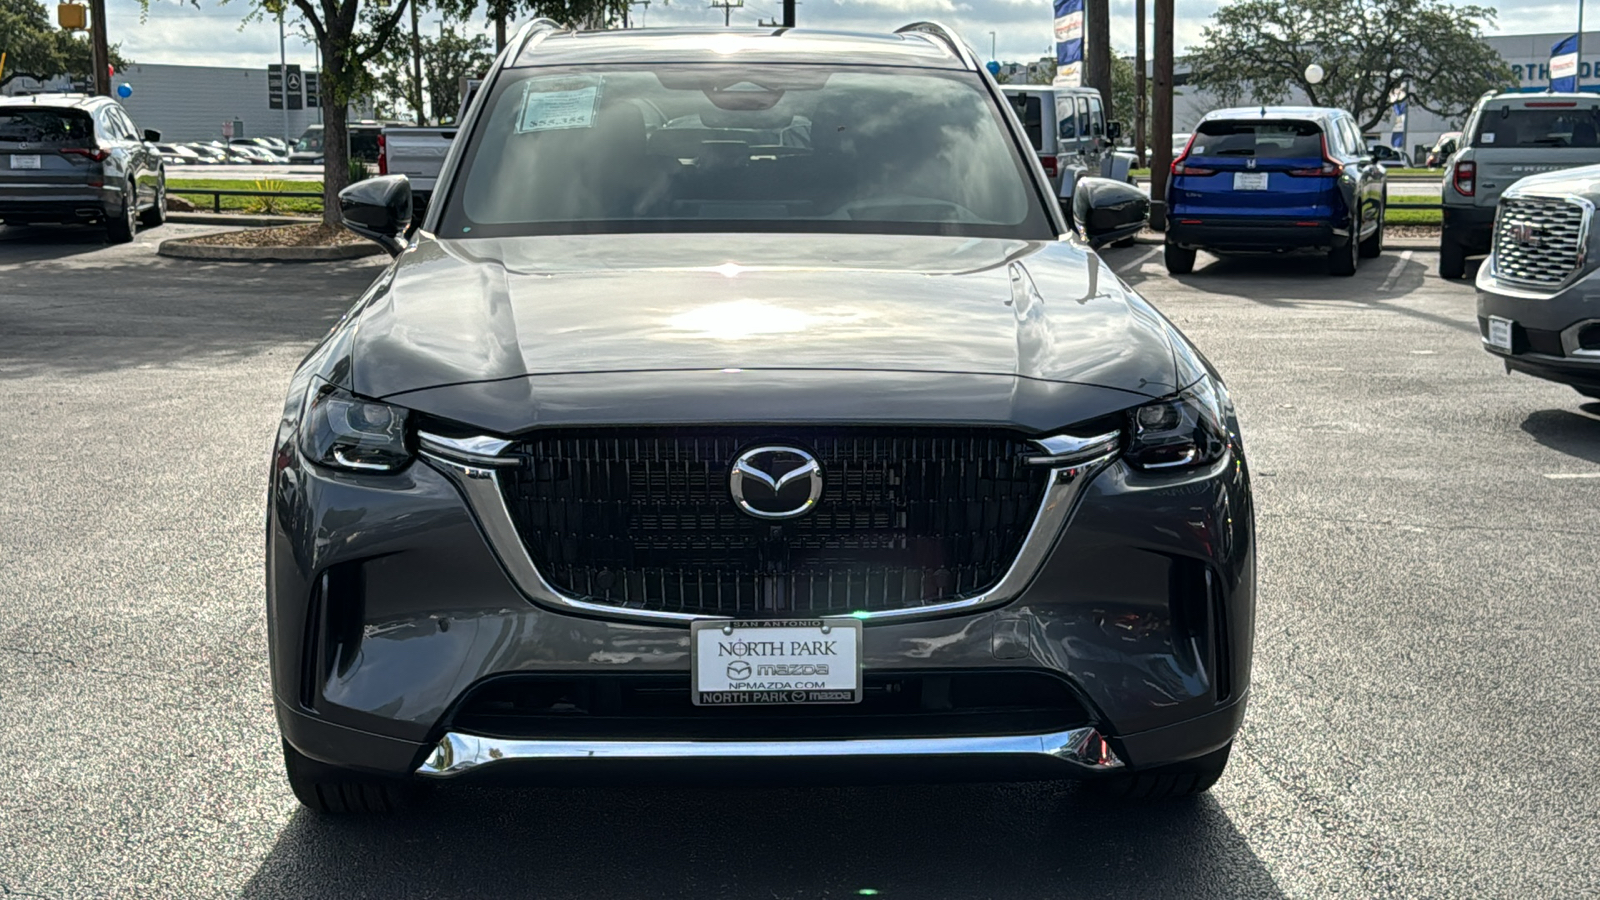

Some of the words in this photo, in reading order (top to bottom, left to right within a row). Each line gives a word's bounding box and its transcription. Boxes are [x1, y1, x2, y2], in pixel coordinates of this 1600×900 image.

[718, 641, 784, 657] NORTH
[790, 641, 837, 656] PARK
[729, 681, 826, 690] NPMAZDA.COM
[703, 692, 749, 703] NORTH
[753, 692, 789, 702] PARK
